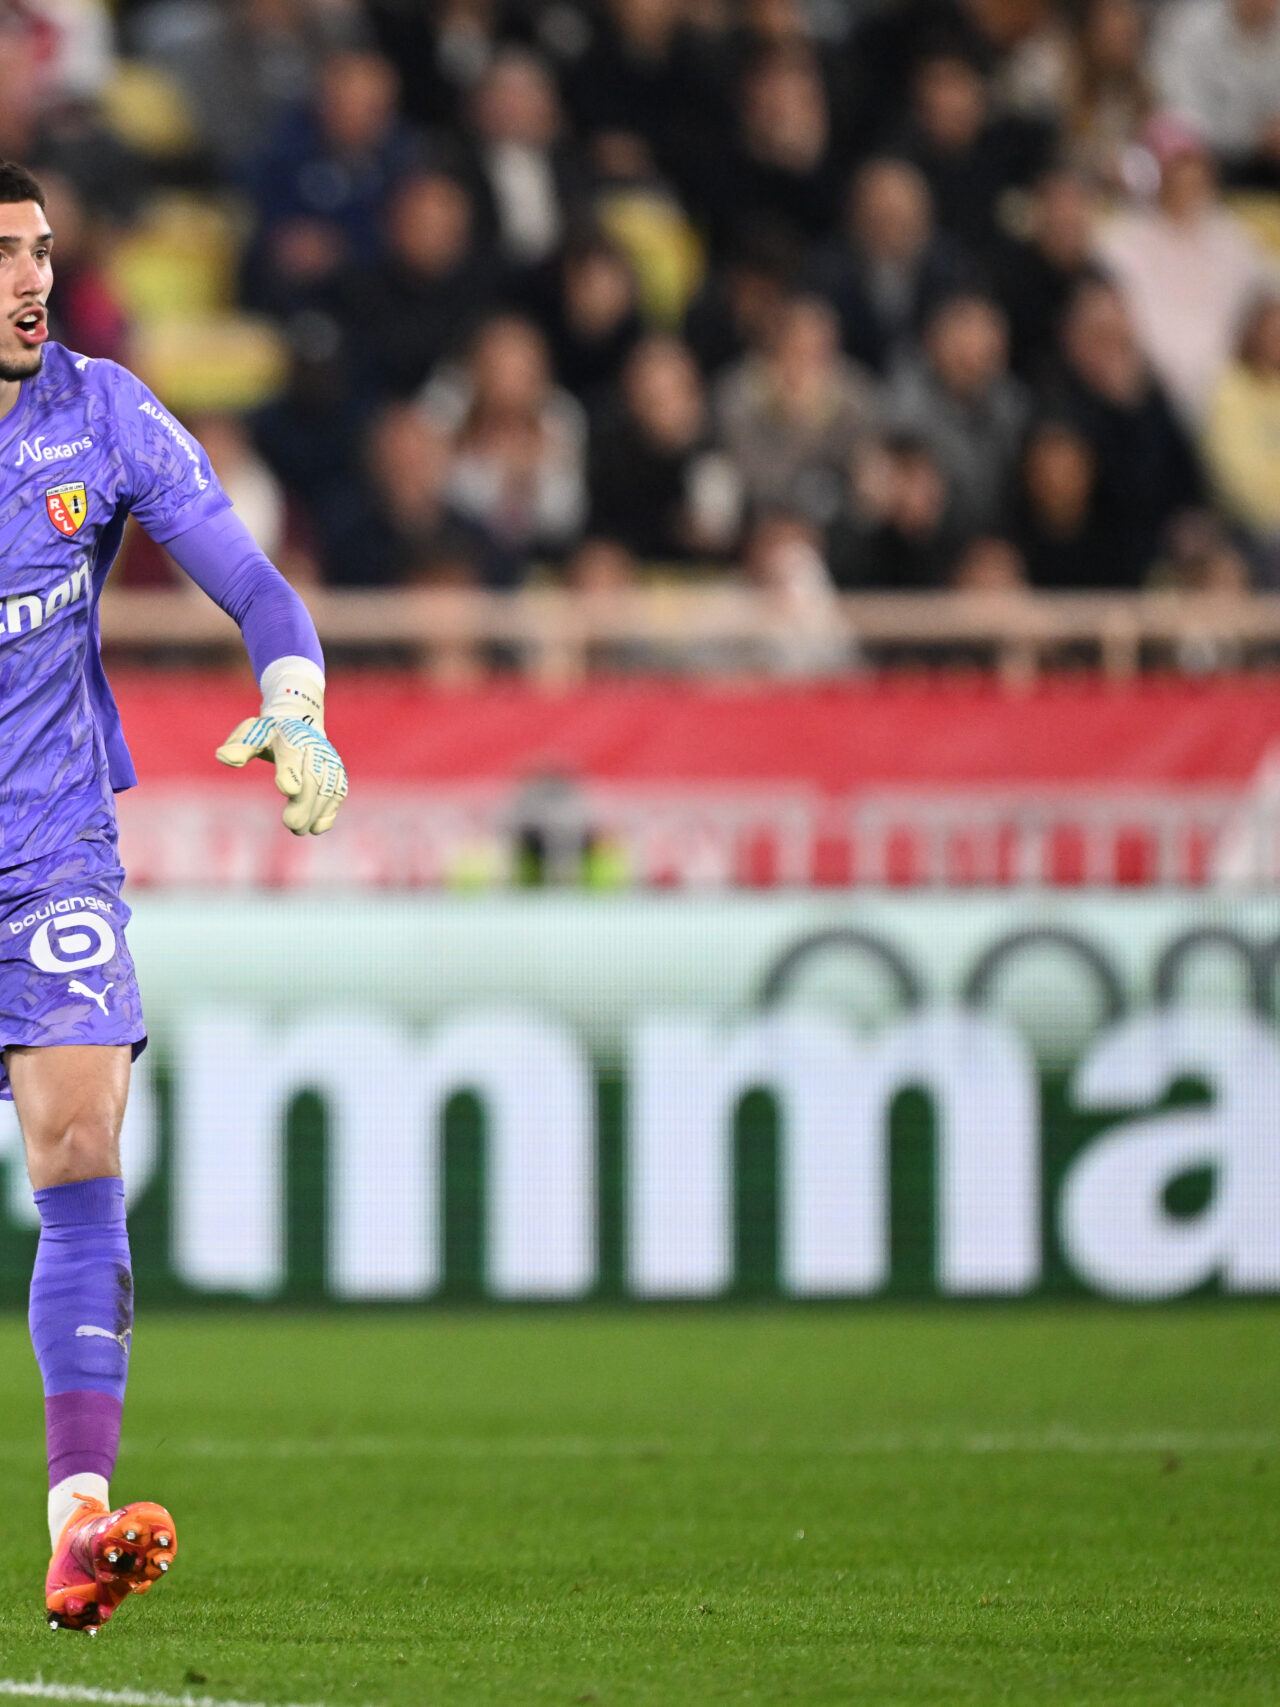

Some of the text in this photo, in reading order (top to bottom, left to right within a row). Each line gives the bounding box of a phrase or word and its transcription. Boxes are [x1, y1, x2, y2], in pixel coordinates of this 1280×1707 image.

[15, 436, 93, 466] Nexans
[49, 498, 73, 531] RCL
[9, 896, 113, 934] boulanger
